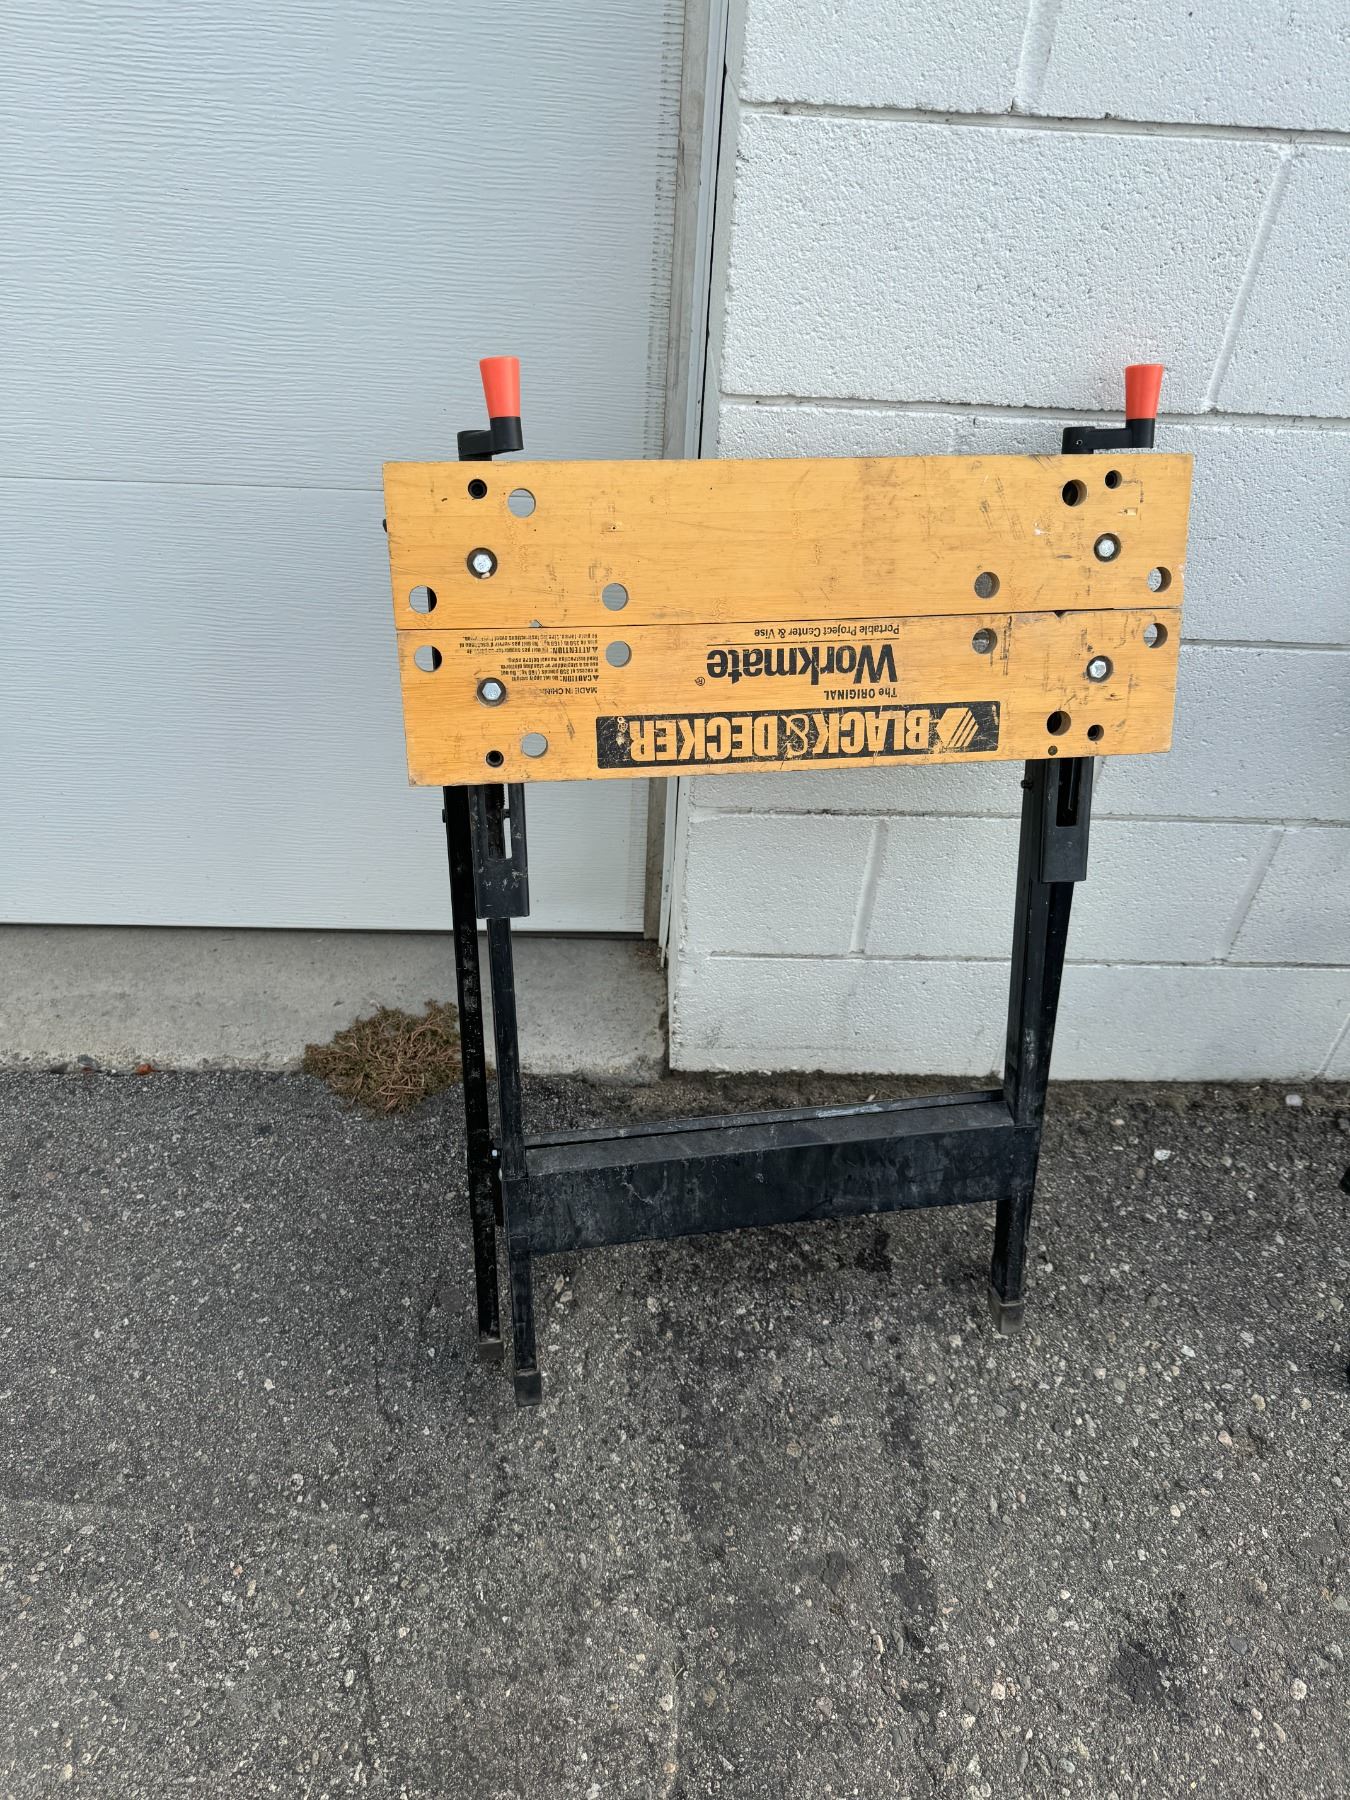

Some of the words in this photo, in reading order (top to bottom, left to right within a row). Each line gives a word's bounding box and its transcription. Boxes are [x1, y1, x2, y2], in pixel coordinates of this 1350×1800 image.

[754, 628, 776, 639] Vise
[778, 628, 786, 638] &
[788, 627, 821, 638] Center
[823, 626, 857, 638] Project
[859, 624, 900, 638] Portable
[823, 688, 876, 701] ORIGINAL
[878, 687, 898, 698] The
